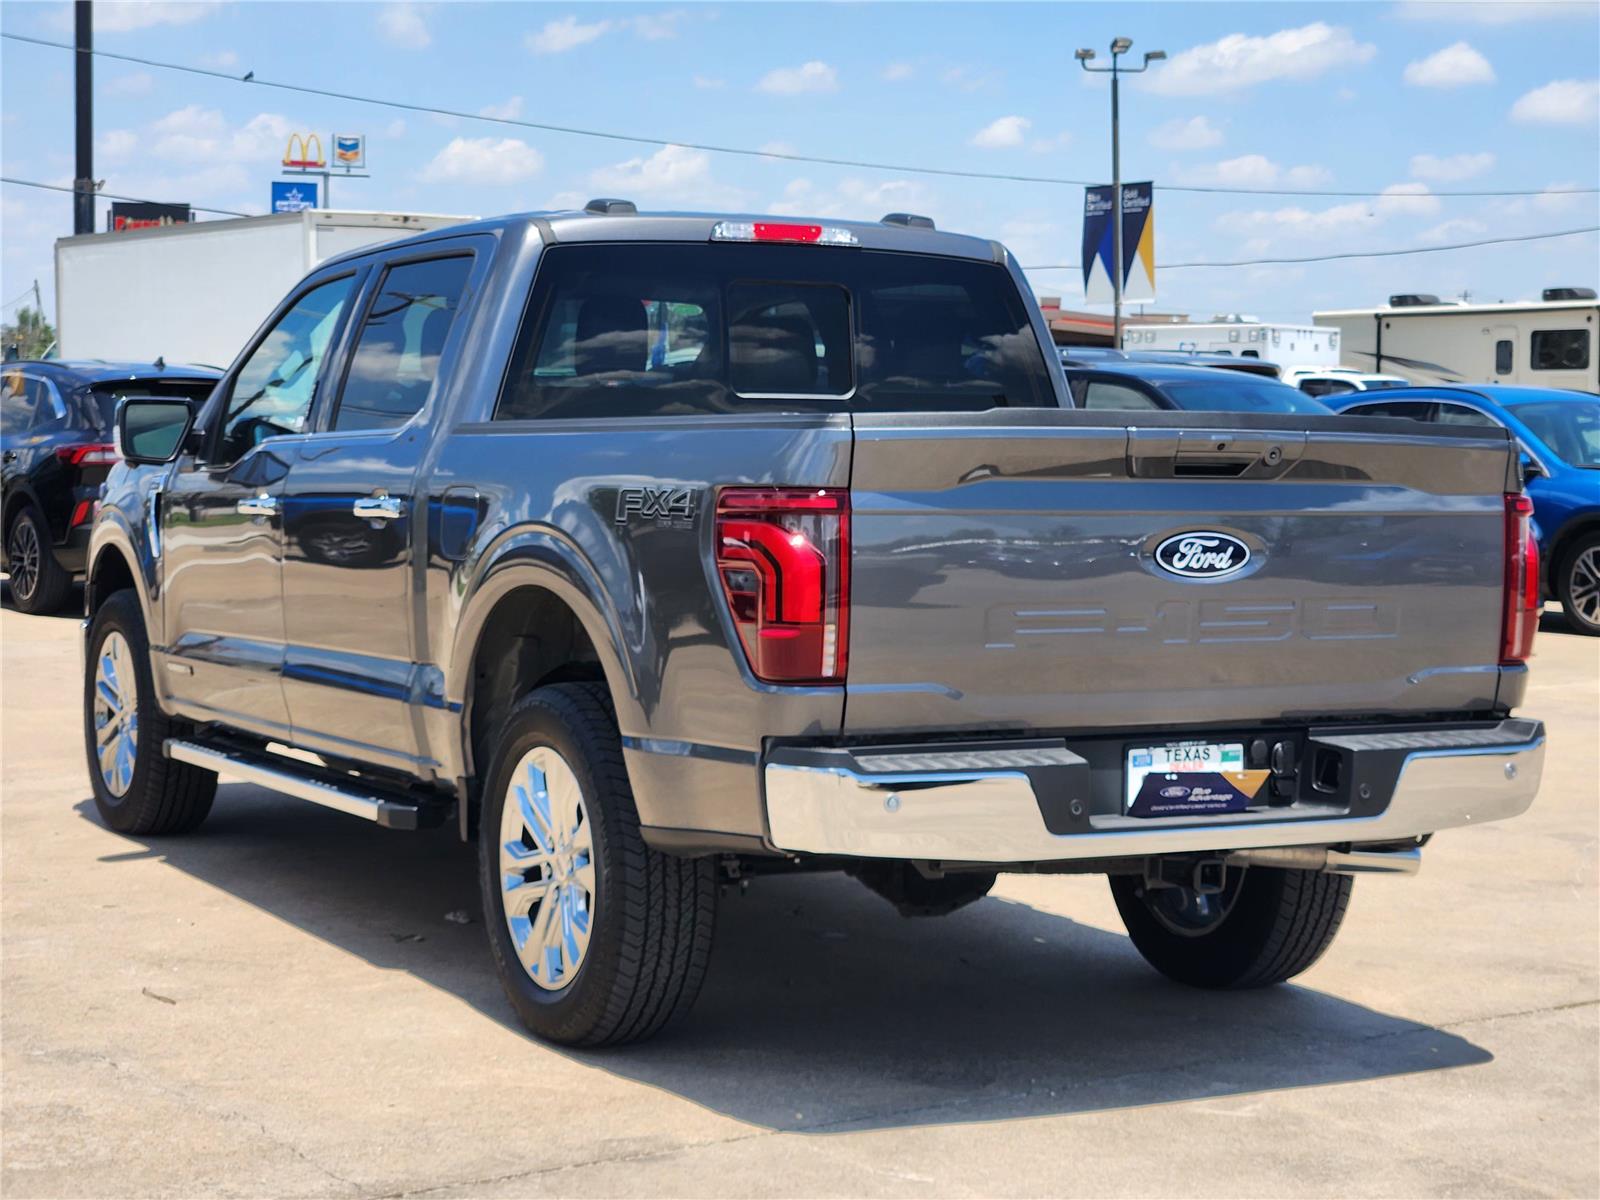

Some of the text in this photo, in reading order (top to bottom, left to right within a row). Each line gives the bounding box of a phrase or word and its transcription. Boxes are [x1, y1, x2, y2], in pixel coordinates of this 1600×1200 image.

[614, 486, 698, 526] FX4
[1172, 537, 1233, 570] Ford
[985, 601, 1399, 649] F-150
[1165, 747, 1211, 762] TEXAS
